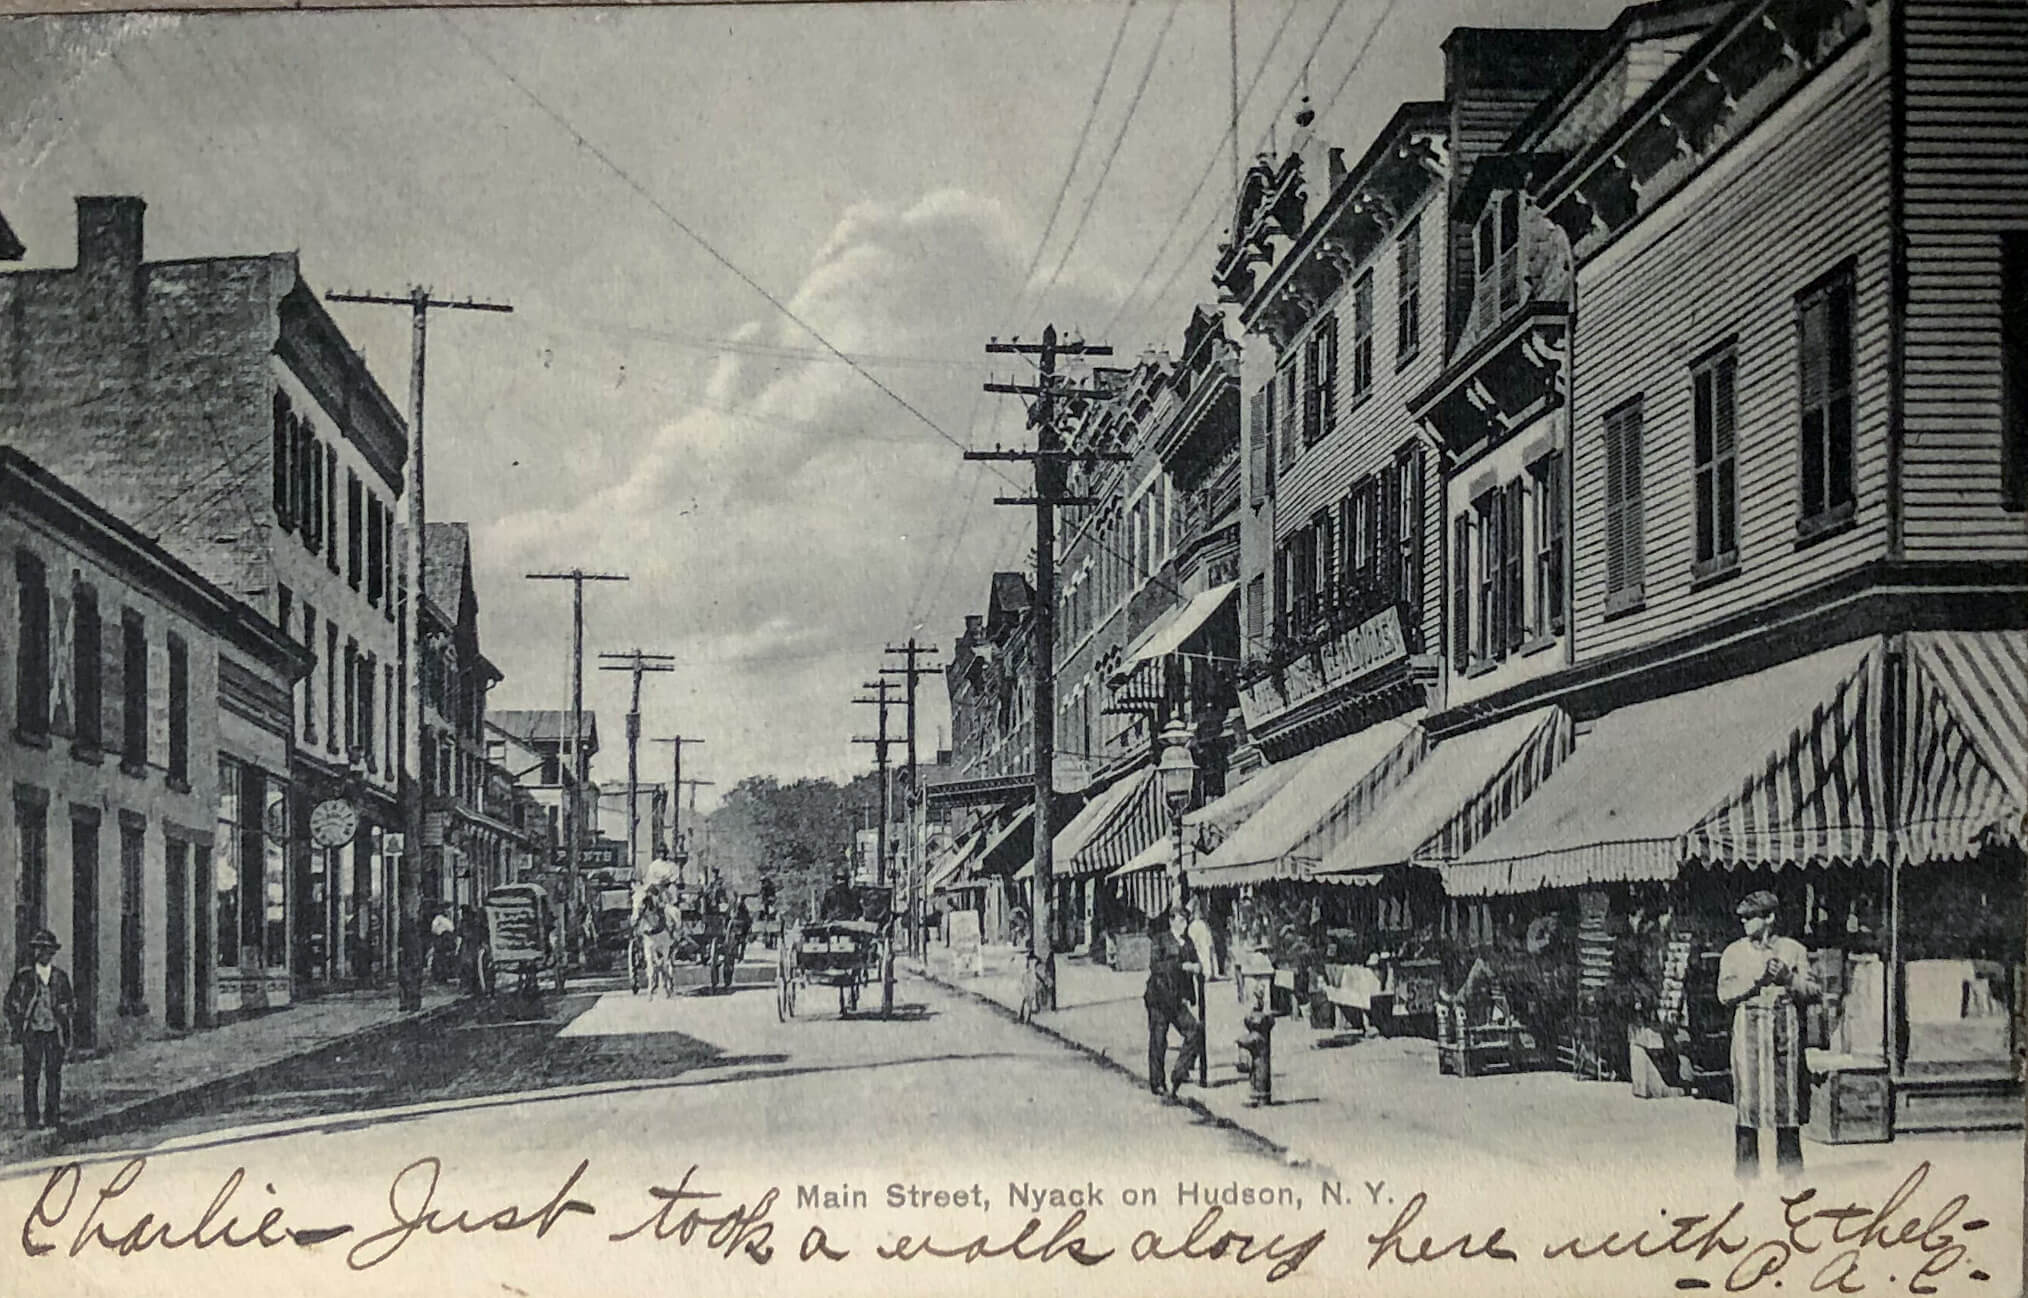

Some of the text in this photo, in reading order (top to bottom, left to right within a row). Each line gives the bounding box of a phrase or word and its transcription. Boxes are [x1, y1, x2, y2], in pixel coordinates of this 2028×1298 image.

[346, 1157, 597, 1271] Just
[609, 1164, 775, 1266] took
[798, 1225, 850, 1262] a
[877, 1208, 1115, 1266] walk
[1131, 1206, 1326, 1283] along
[1368, 1192, 1517, 1270] here
[1543, 1202, 1750, 1262] with
